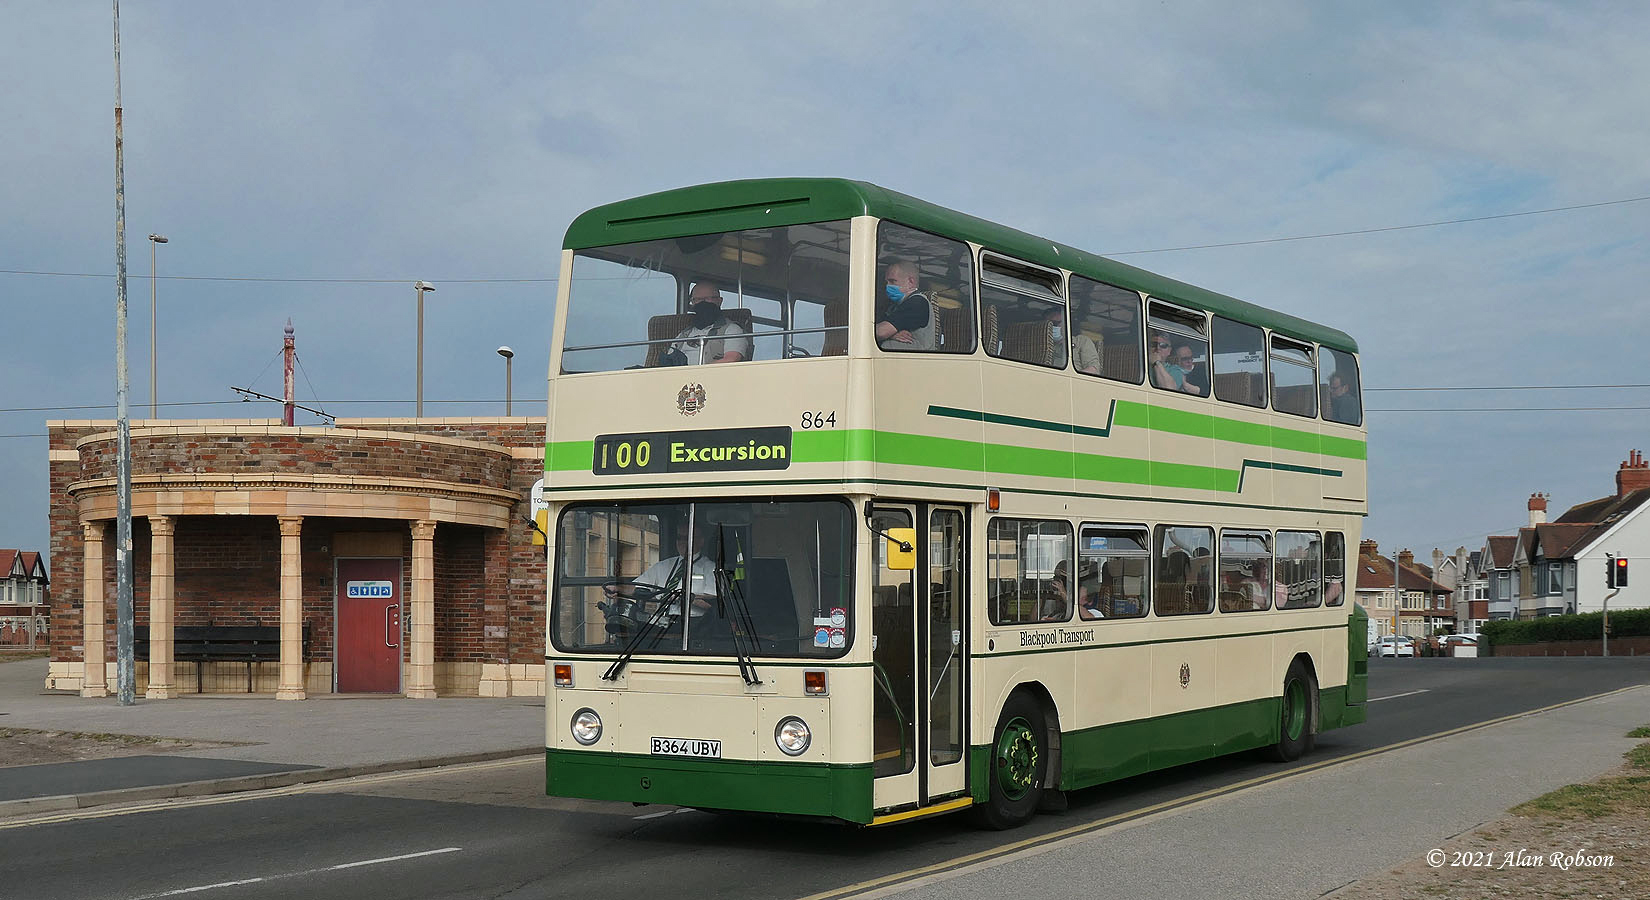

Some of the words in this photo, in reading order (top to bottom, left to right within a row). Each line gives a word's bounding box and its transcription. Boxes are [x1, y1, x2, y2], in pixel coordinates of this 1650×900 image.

[801, 410, 836, 429] 864
[601, 441, 651, 469] 100
[671, 440, 786, 463] Excursion
[1020, 629, 1057, 648] Blackpool
[1059, 628, 1095, 645] Transport
[653, 739, 688, 754] B364
[692, 741, 719, 756] UBV
